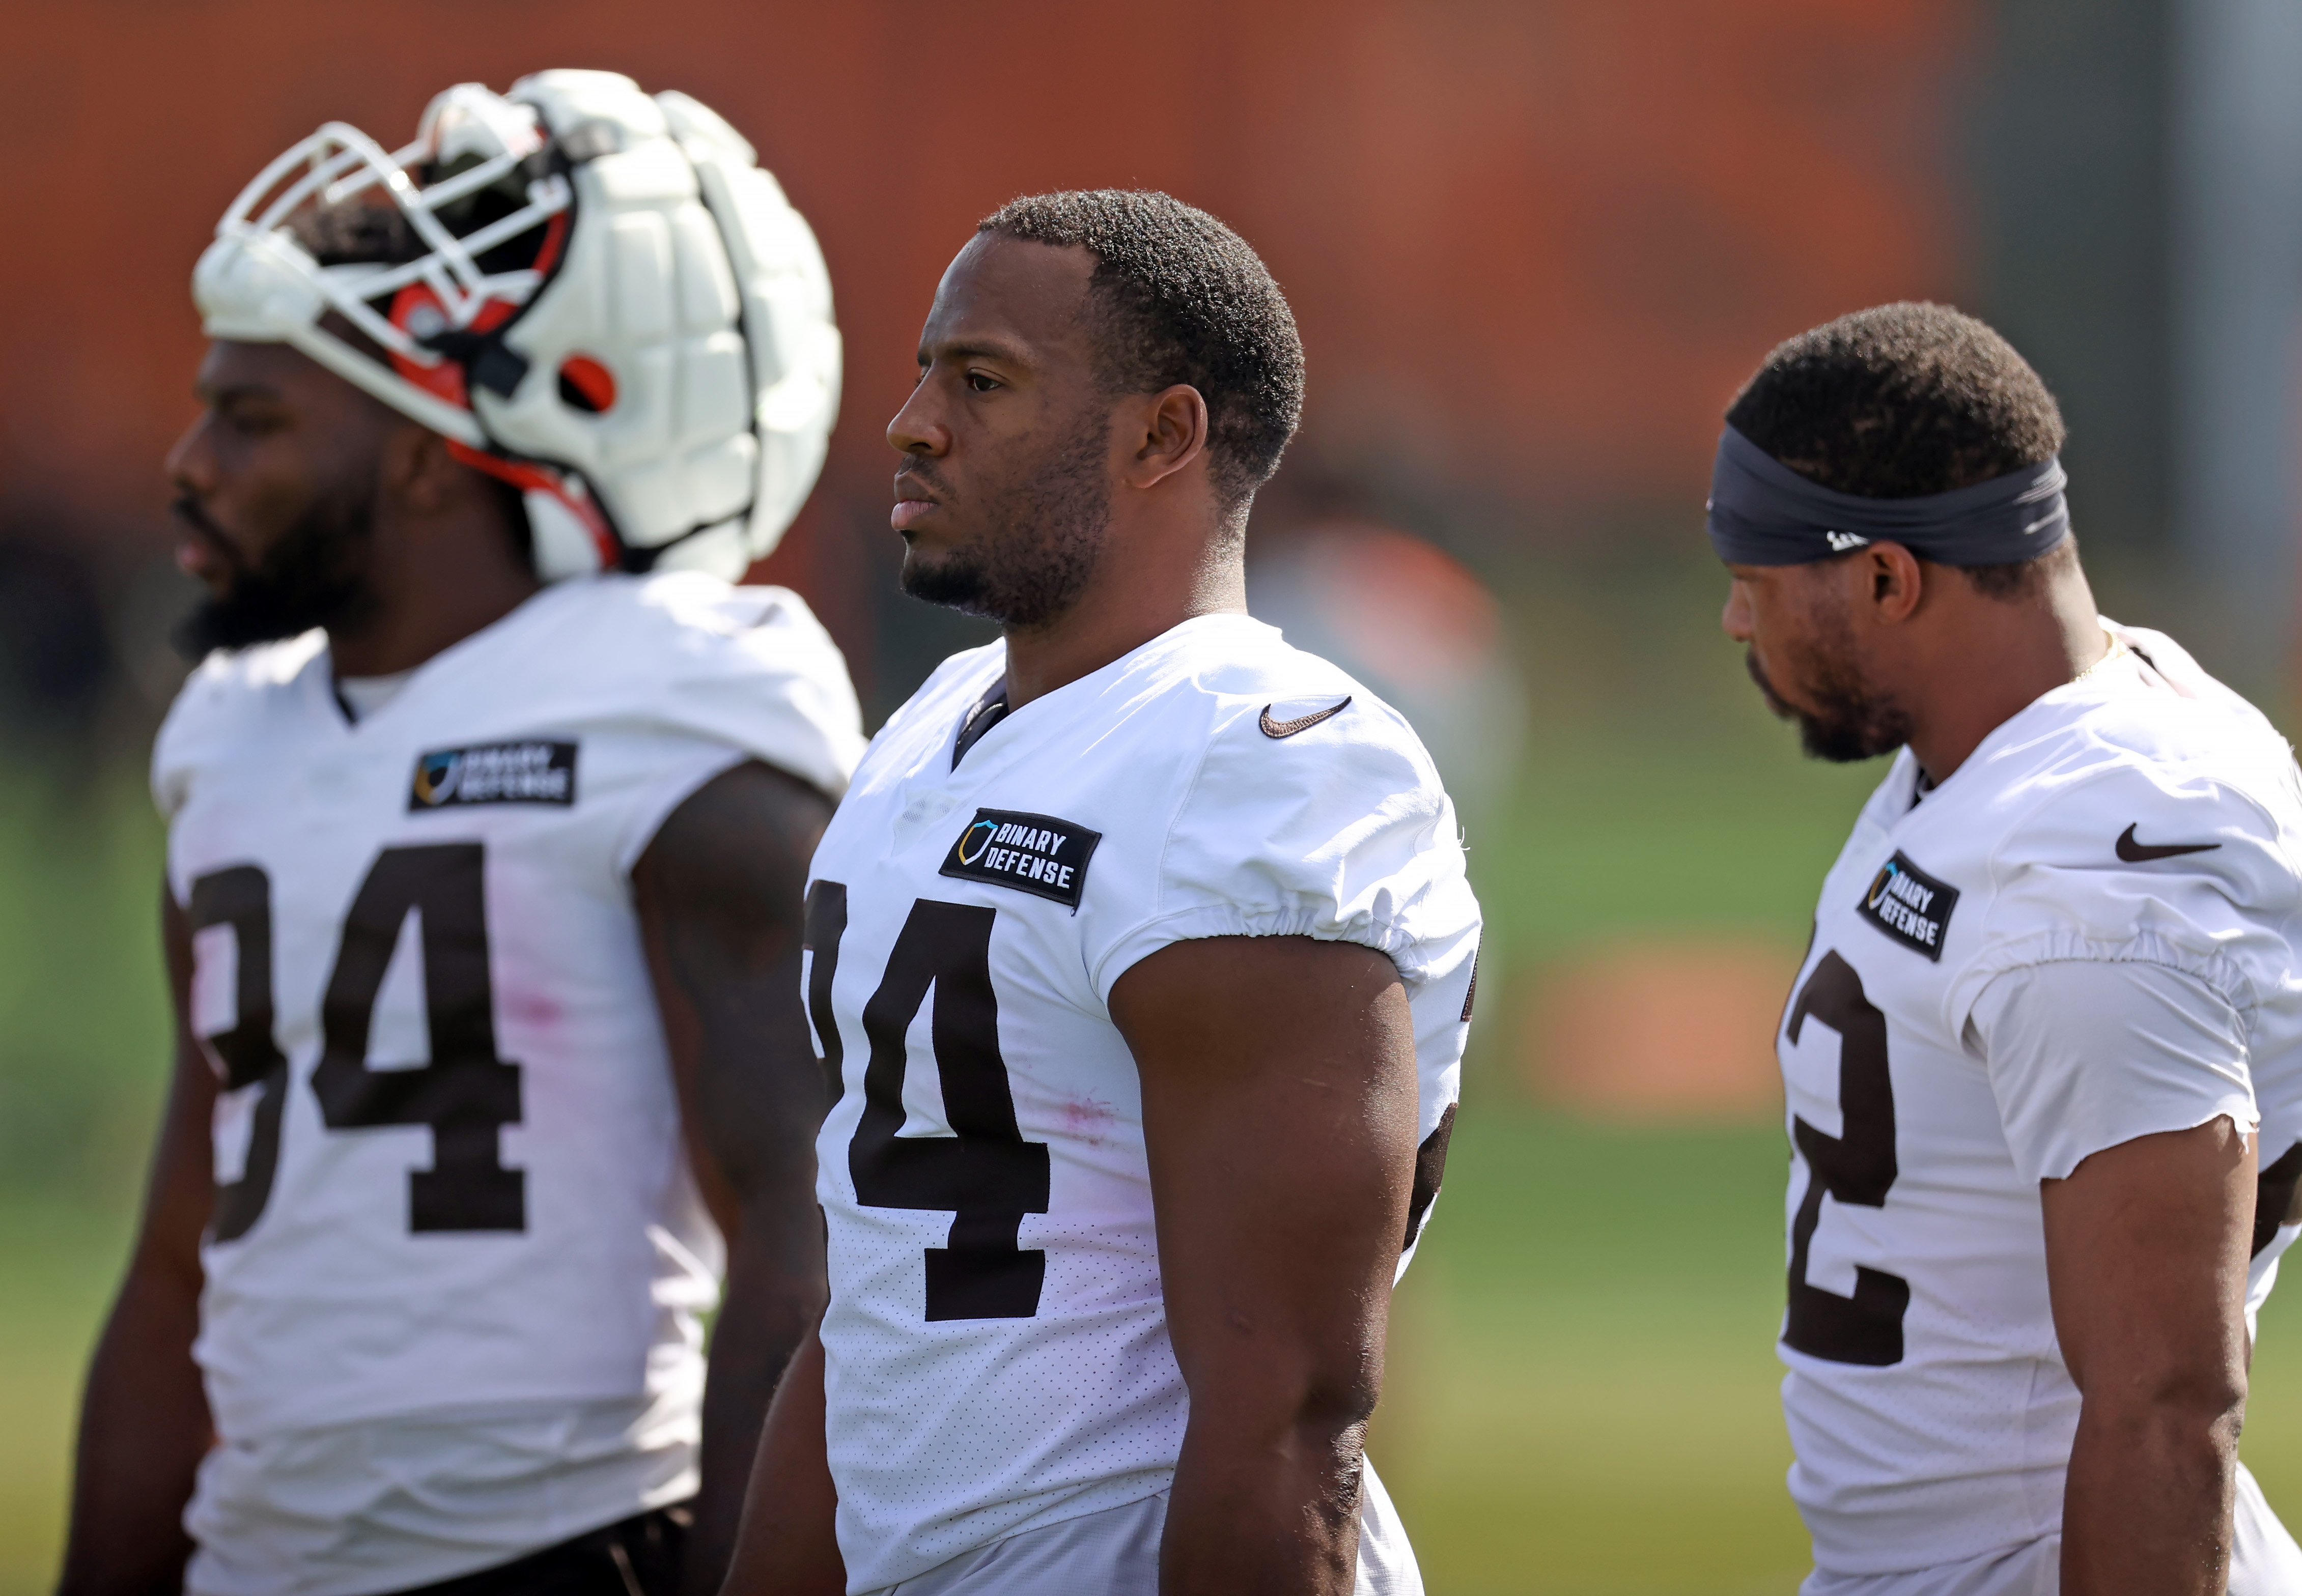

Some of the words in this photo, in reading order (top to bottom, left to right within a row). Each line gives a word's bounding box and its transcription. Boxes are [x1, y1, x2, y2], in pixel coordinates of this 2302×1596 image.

[995, 823, 1067, 856] BINARY
[984, 847, 1075, 889] DEFENSE
[1878, 894, 1940, 947] DEFENSE
[1780, 947, 1910, 1367] 2
